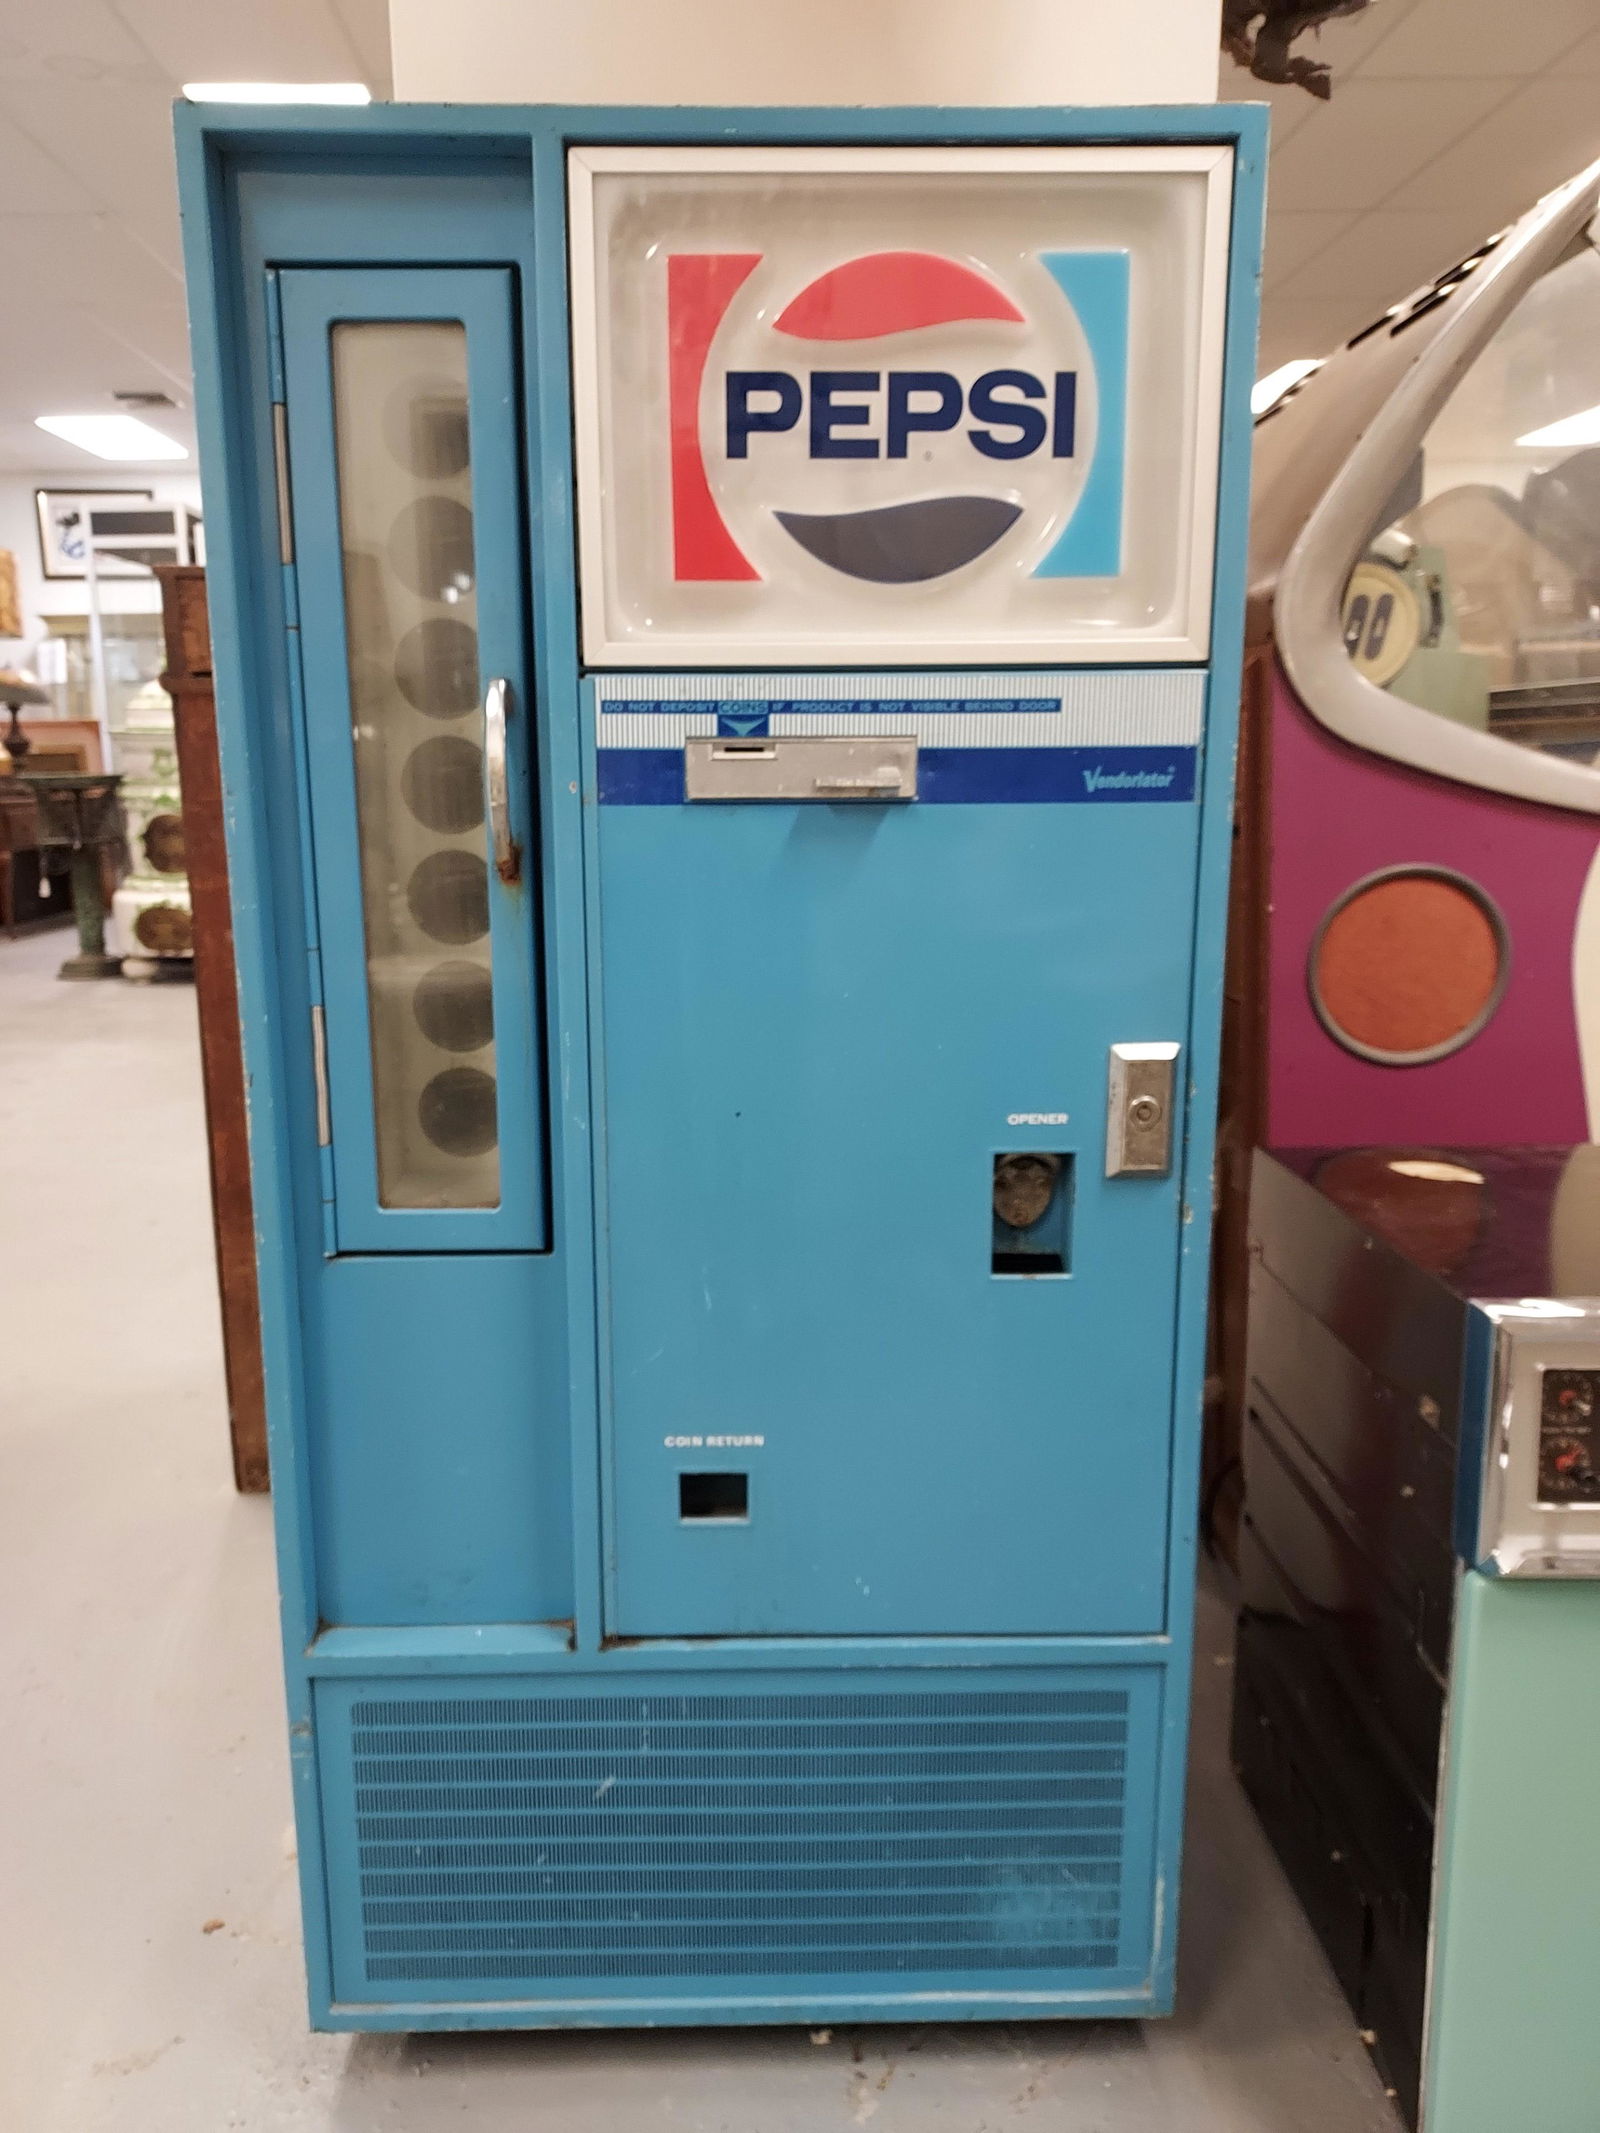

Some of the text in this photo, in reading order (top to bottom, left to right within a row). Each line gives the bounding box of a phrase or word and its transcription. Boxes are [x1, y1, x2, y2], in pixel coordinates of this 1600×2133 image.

[725, 369, 1078, 460] PEPSI
[604, 701, 1057, 713] DO NOT DEPOSIT COINS IF PRODUCT IS NOT VISIBLE BEHIND DOOR
[1007, 1113, 1069, 1126] OPENER
[663, 1435, 765, 1448] COIN RETURN
